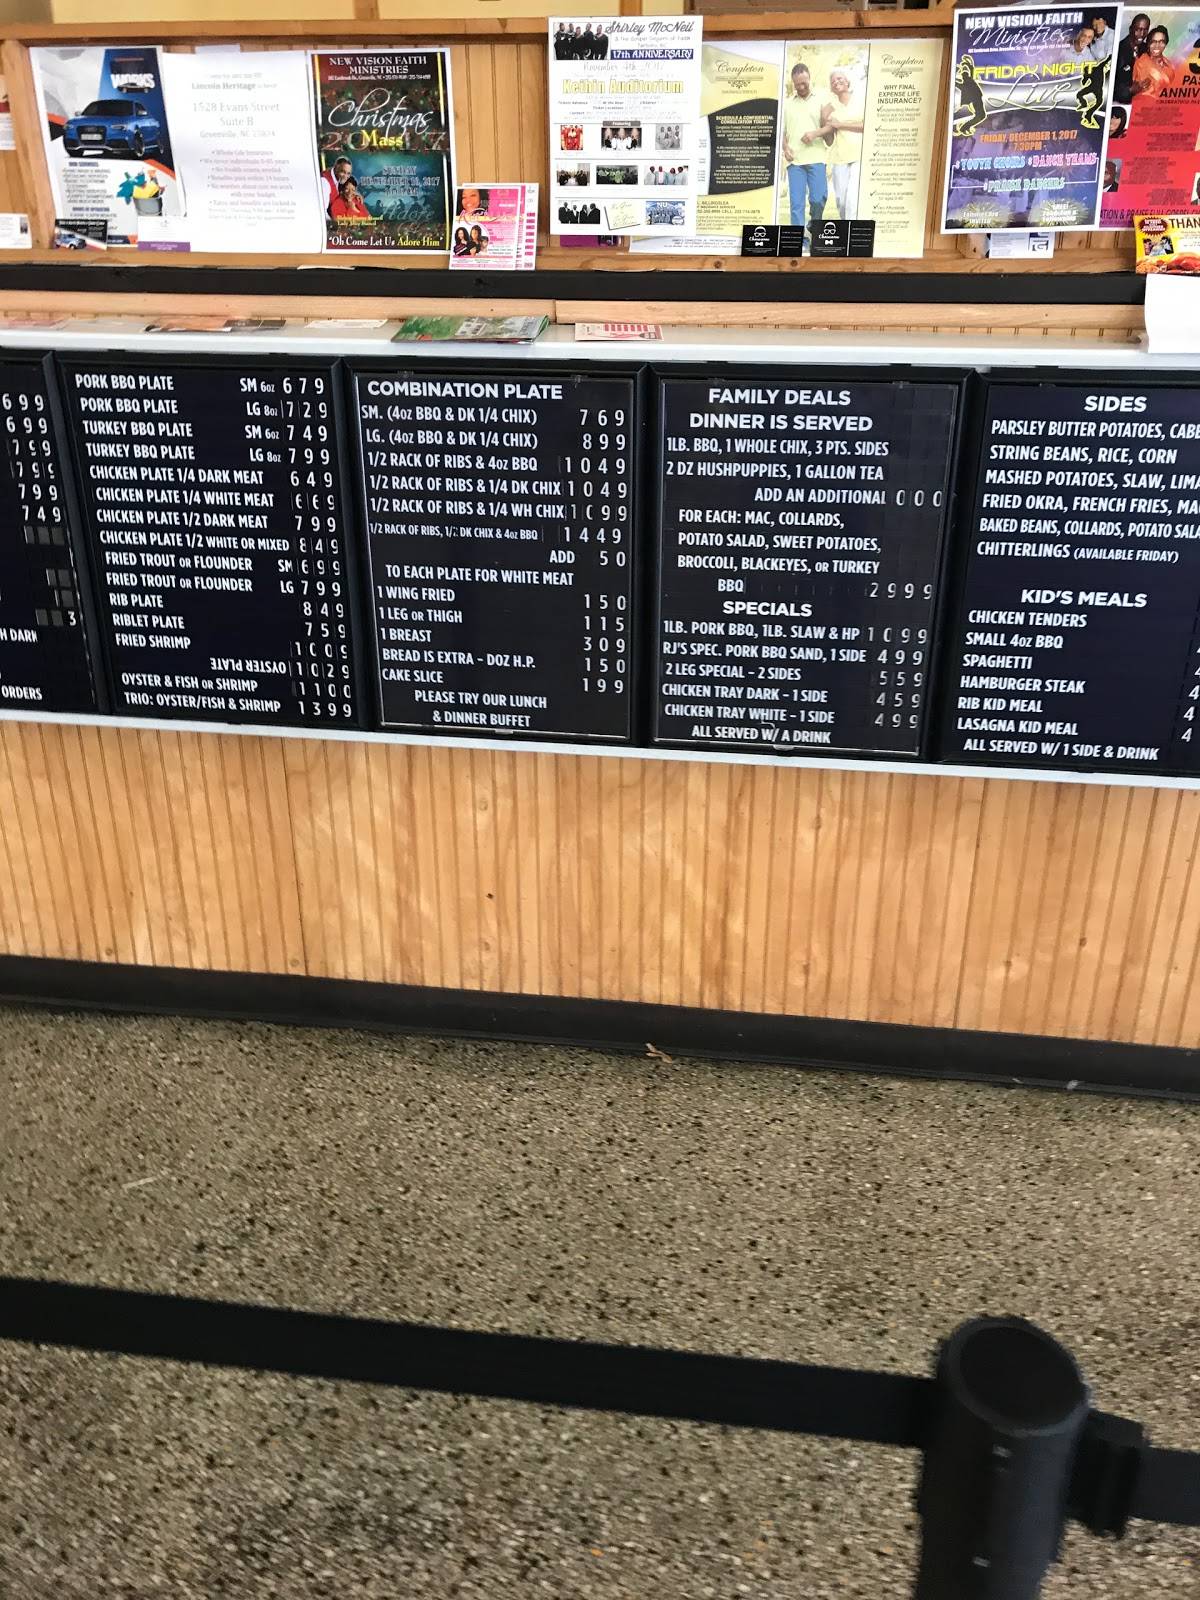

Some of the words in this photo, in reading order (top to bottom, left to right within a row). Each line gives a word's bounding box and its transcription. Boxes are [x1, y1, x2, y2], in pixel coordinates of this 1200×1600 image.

[604, 21, 646, 36] Shirley
[649, 21, 694, 35] McNeil
[965, 16, 995, 29] NEW
[1001, 14, 1043, 27] VISION
[1045, 12, 1083, 24] FAITH
[969, 22, 1073, 56] Ministries
[329, 57, 353, 66] NEW
[356, 56, 392, 65] VISION
[395, 55, 427, 65] FAITH
[612, 49, 631, 59] 17th
[632, 49, 694, 60] ANNIVERSARY
[881, 54, 924, 68] Congleton
[349, 65, 409, 75] MINISTRIES
[715, 60, 764, 77] Congleton
[973, 64, 1039, 79] FRIDAY
[1043, 61, 1098, 76] NIGHT
[222, 82, 256, 91] Heritage
[609, 79, 684, 94] Auditorium
[983, 72, 1072, 112] Live
[219, 102, 249, 112] Evans
[250, 102, 280, 112] Street
[328, 87, 434, 138] Christmas
[219, 116, 244, 126] Suite
[361, 129, 404, 147] Mass
[980, 133, 1006, 144] FRIDAY,
[1010, 131, 1051, 142] DECEMBER
[1059, 130, 1078, 140] 2017
[961, 157, 992, 170] YOUTH
[1032, 154, 1064, 167] DANCE
[346, 237, 369, 246] Come
[370, 237, 383, 246] Let
[384, 237, 396, 247] Us
[397, 235, 421, 247] Adore
[74, 373, 109, 389] PORK
[110, 374, 136, 390] BBQ
[138, 375, 174, 391] PLATE
[239, 377, 258, 393] SM
[367, 380, 499, 399] COMBINATION
[503, 383, 563, 400] PLATE
[708, 388, 780, 405] FAMILY
[784, 389, 851, 406] DEALS
[1083, 395, 1148, 413] SIDES
[361, 404, 384, 420] SM.
[415, 406, 442, 421] BBQ
[444, 406, 455, 422] &
[457, 407, 476, 422] DK
[478, 406, 499, 424] 1/4
[501, 408, 538, 426] CHIX)
[689, 412, 765, 429] DINNER
[770, 414, 788, 430] IS
[792, 414, 873, 432] SERVED
[82, 420, 128, 436] TURKEY
[130, 421, 156, 436] BBQ
[157, 422, 193, 437] PLATE
[991, 419, 1047, 436] PARSLEY
[1047, 420, 1097, 437] BUTTER
[1098, 421, 1166, 441] POTATOES,
[989, 444, 1040, 461] STRING
[1042, 446, 1093, 465] BEANS,
[1097, 447, 1134, 466] RICE,
[1137, 448, 1178, 464] CORN
[89, 465, 138, 481] CHICKEN
[140, 466, 175, 482] PLATE
[176, 467, 196, 484] 1/4
[197, 468, 231, 484] DARK
[233, 469, 264, 485] MEAT
[666, 461, 674, 476] 2
[677, 461, 694, 476] DZ
[697, 461, 792, 481] HUSHPUPPIES,
[795, 464, 802, 479] 1
[804, 464, 856, 480] GALLON
[859, 465, 884, 481] TEA
[979, 517, 1018, 533] BAKED
[1019, 518, 1061, 537] BEANS,
[1064, 520, 1125, 539] COLLARDS,
[1127, 522, 1173, 538] POTATO
[105, 551, 138, 566] FRIED
[139, 552, 176, 568] TROUT
[193, 555, 253, 571] FLOUNDER
[976, 541, 1071, 559] CHITTERLINGS
[1073, 547, 1135, 561] (AVAILABLE
[1135, 549, 1179, 564] FRIDAY)
[677, 554, 738, 572] BROCCOLI,
[741, 556, 812, 575] BLACKEYES,
[832, 559, 880, 574] TURKEY
[385, 564, 401, 578] TO
[403, 565, 434, 580] EACH
[436, 566, 472, 581] PLATE
[474, 568, 498, 583] FOR
[500, 569, 540, 584] WHITE
[542, 571, 574, 586] MEAT
[1020, 589, 1074, 605] KID'S
[1077, 591, 1148, 608] MEALS
[378, 606, 385, 620] 1
[387, 606, 409, 621] LEG
[426, 608, 463, 623] THIGH
[722, 600, 813, 617] SPECIALS
[112, 613, 149, 628] RIBLET
[151, 614, 185, 630] PLATE
[965, 631, 1007, 647] SMALL
[1034, 634, 1064, 649] BBQ
[382, 647, 421, 662] BREAD
[423, 650, 435, 663] IS
[437, 650, 475, 665] EXTRA
[486, 653, 511, 667] DOZ
[512, 654, 536, 668] H.P.
[662, 641, 688, 655] RJ'S
[689, 642, 722, 657] SPEC.
[725, 644, 759, 658] PORK
[761, 645, 787, 659] BBQ
[789, 646, 827, 663] SAND,
[830, 648, 837, 661] 1
[838, 648, 867, 663] SIDE
[381, 668, 411, 682] CAKE
[413, 669, 444, 684] SLICE
[960, 675, 1043, 692] HAMBURGER
[1044, 679, 1086, 694] STEAK
[1, 685, 43, 701] ORDERS
[123, 691, 154, 706] TRIO:
[156, 693, 226, 710] OYSTER/FISH
[228, 697, 237, 710] &
[238, 698, 281, 713] SHRIMP
[414, 689, 456, 704] PLEASE
[457, 691, 480, 705] TRY
[482, 693, 507, 707] OUR
[509, 694, 547, 709] LUNCH
